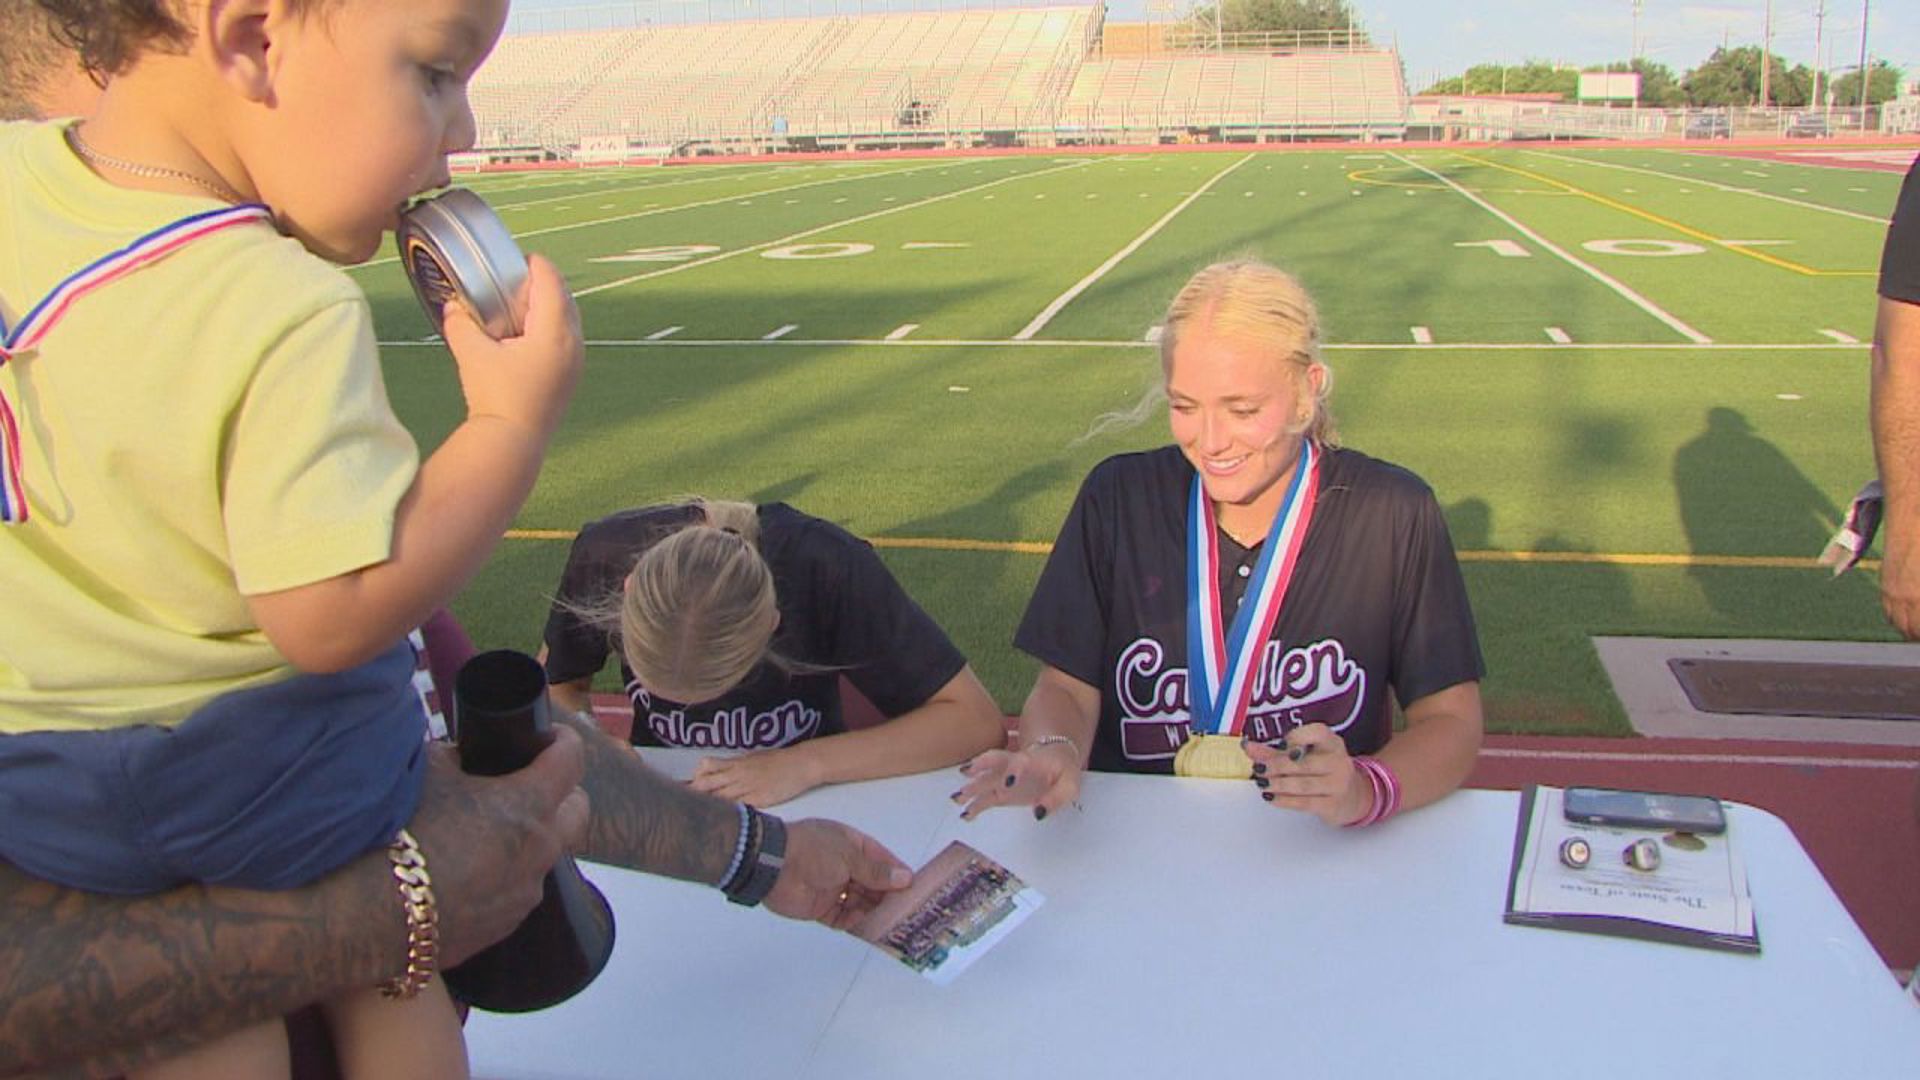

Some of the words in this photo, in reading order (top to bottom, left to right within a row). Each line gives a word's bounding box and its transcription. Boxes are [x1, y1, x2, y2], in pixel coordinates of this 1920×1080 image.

[1454, 239, 1707, 257] 10
[1116, 638, 1365, 720] Callen
[1674, 895, 1707, 910] The
